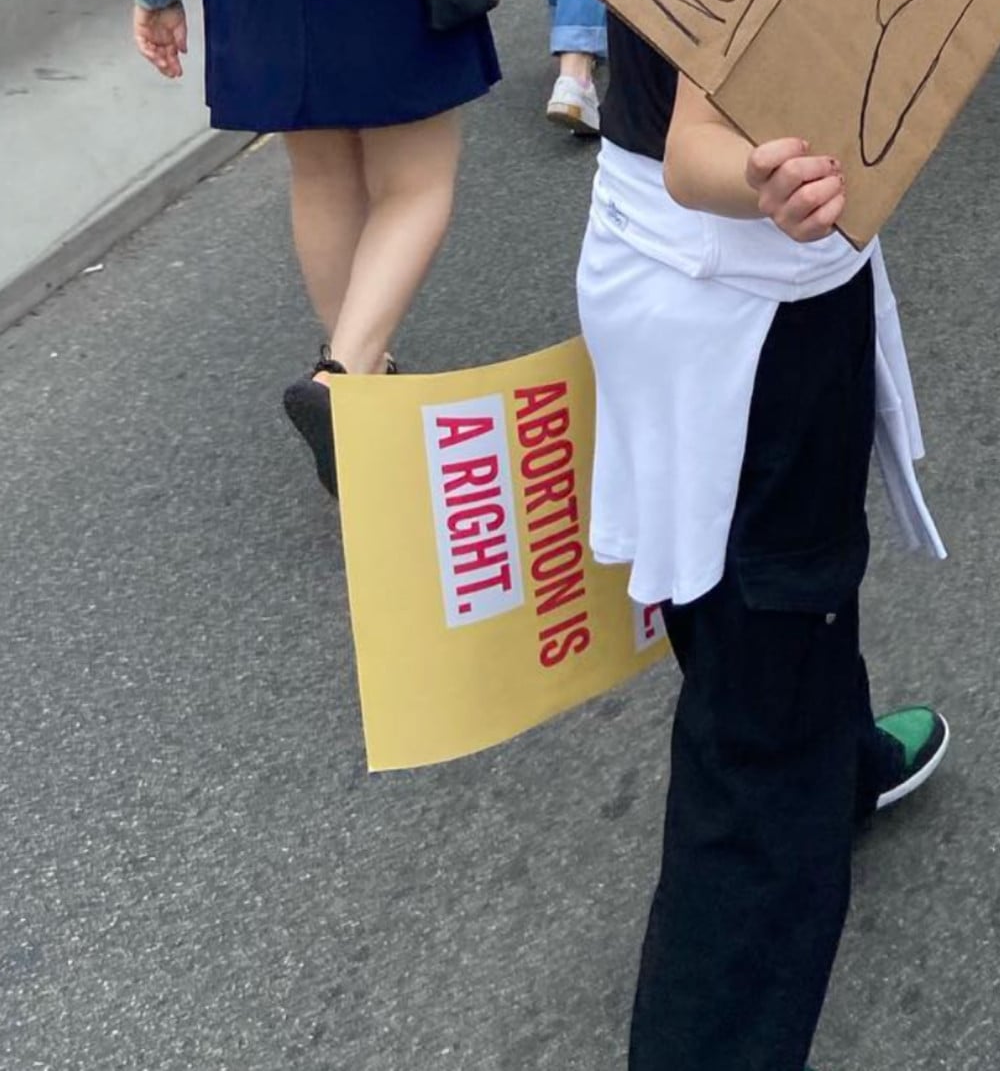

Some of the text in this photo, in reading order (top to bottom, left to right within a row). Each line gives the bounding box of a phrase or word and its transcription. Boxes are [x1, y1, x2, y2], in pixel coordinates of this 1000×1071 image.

[436, 416, 513, 615] A RIGHT.
[513, 380, 591, 669] ABORTION IS
